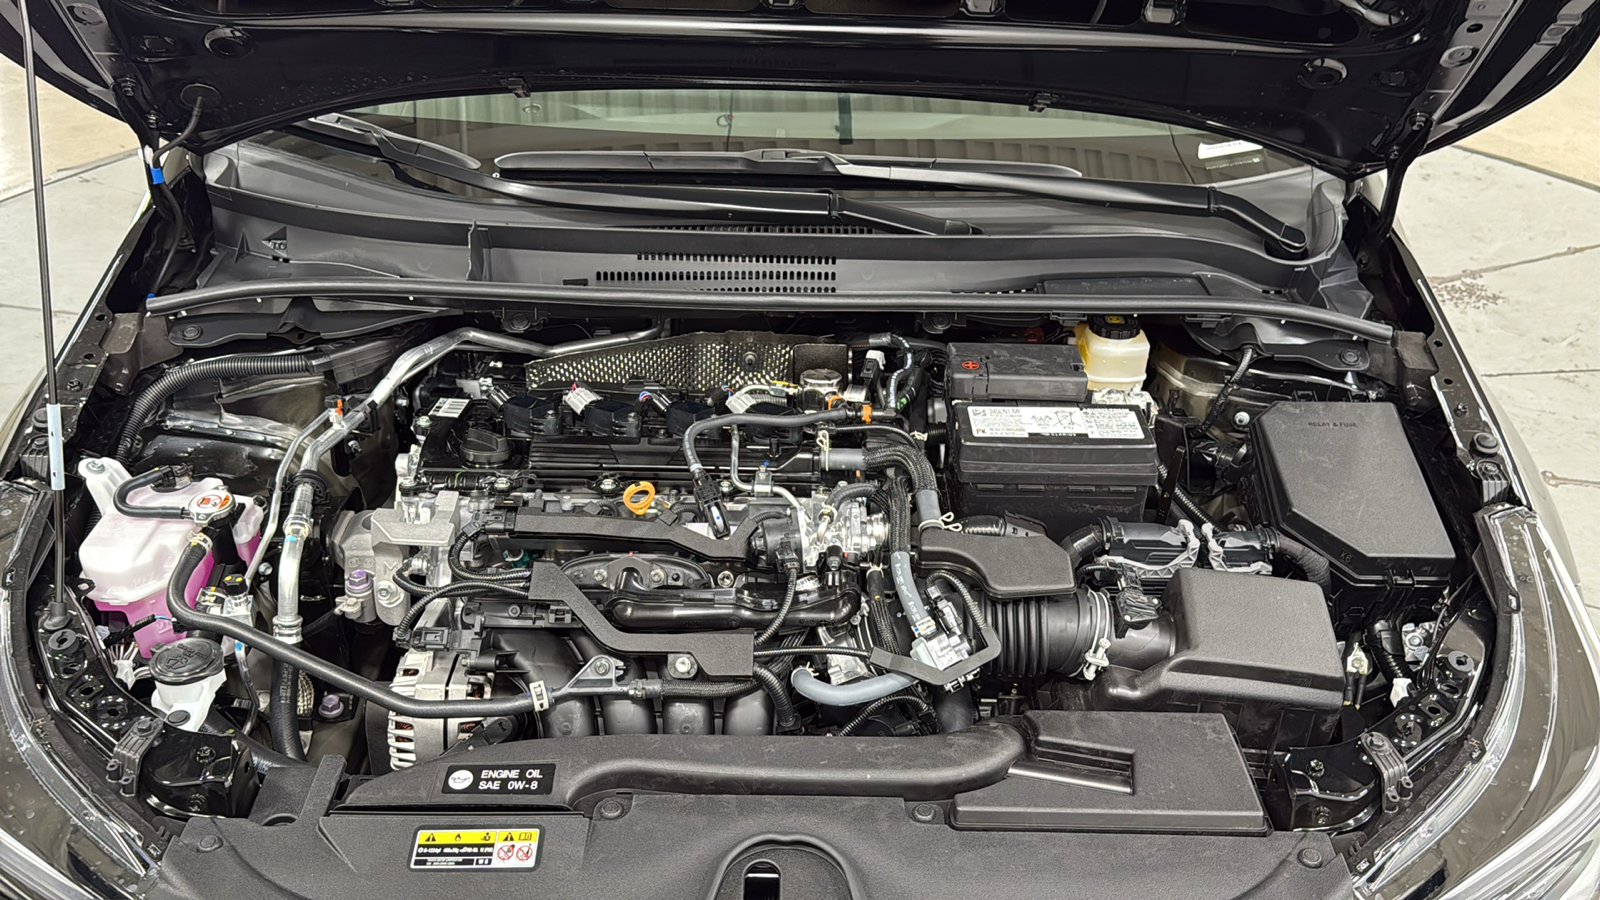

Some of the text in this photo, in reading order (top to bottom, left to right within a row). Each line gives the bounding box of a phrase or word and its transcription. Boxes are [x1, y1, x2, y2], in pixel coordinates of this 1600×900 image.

[1340, 550, 1353, 563] K6
[480, 769, 543, 779] ENGINE OIL
[478, 780, 539, 790] SAE 0W-8
